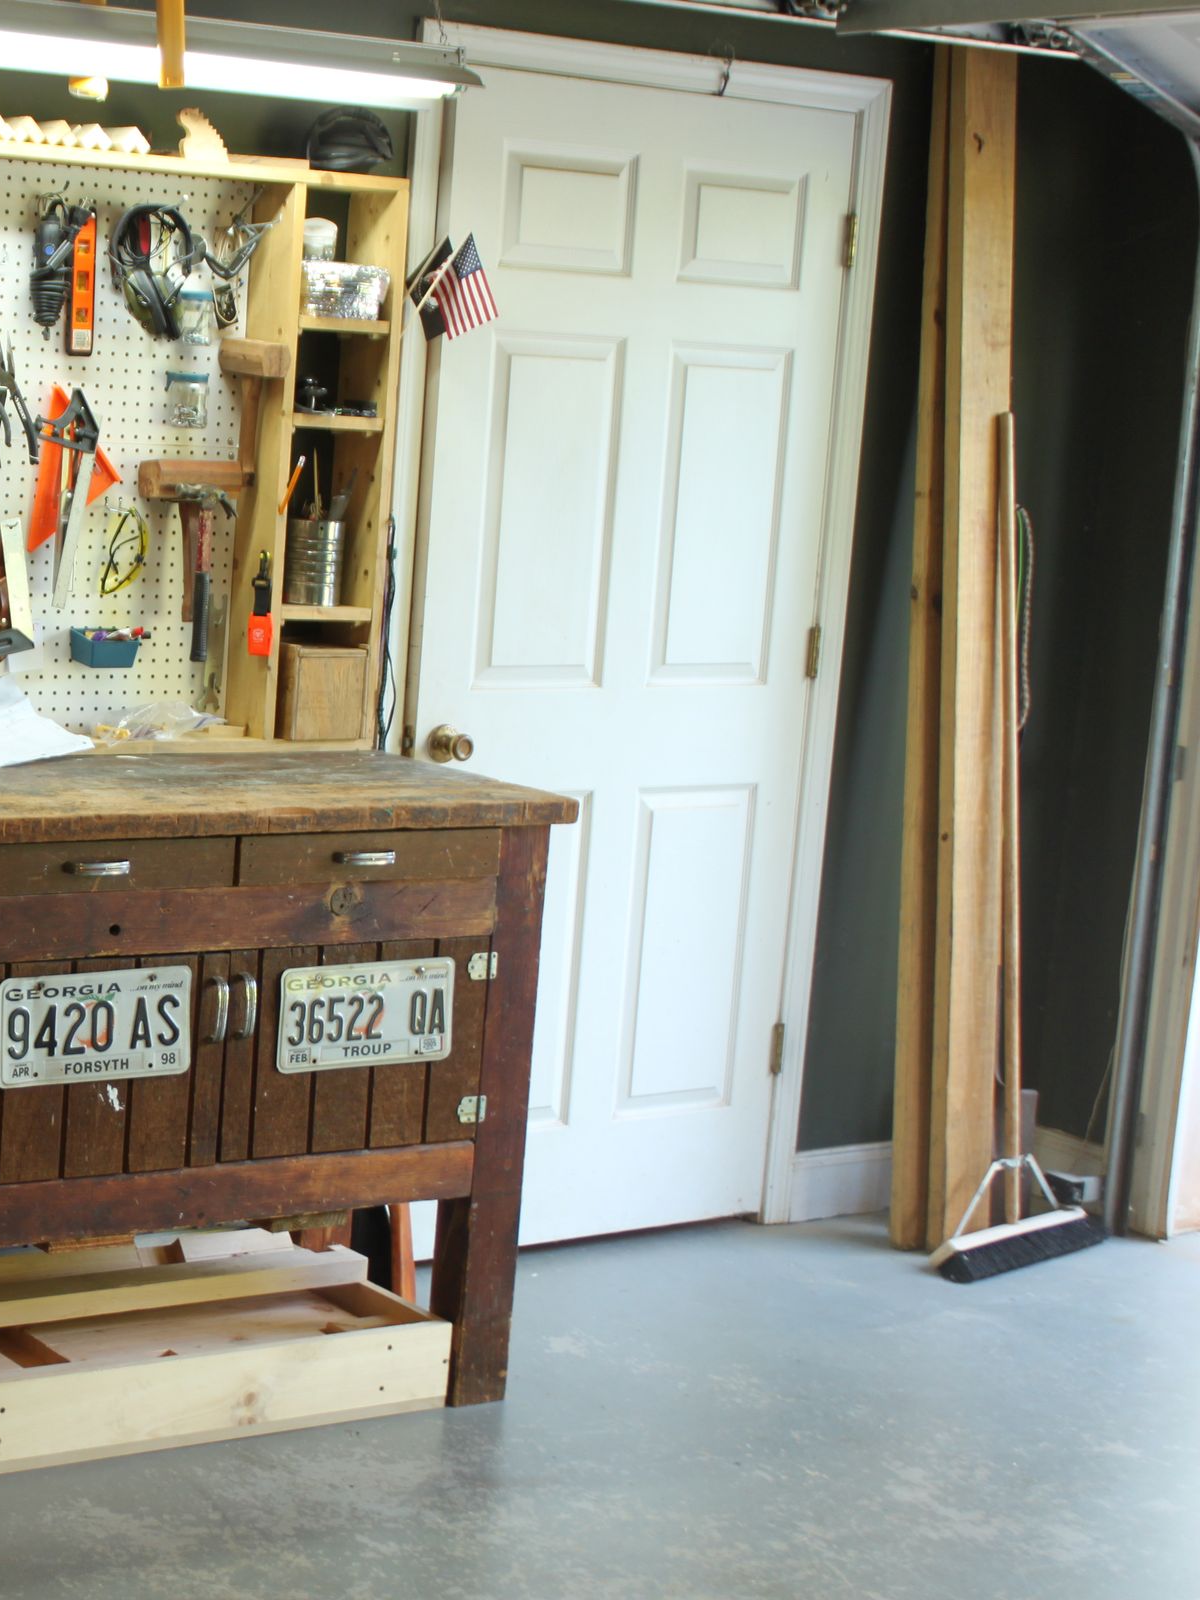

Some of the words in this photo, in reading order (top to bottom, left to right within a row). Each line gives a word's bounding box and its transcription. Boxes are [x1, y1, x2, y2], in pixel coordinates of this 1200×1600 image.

[5, 982, 122, 1001] GEORGIA
[162, 980, 183, 989] mind
[287, 973, 392, 991] GEORGIA
[289, 992, 385, 1046] 36522
[409, 988, 445, 1035] QA
[8, 1000, 115, 1060] 9420
[130, 994, 180, 1050] AS
[161, 1053, 176, 1065] 98
[289, 1052, 308, 1064] FEB
[342, 1043, 392, 1058] TROUP
[12, 1066, 30, 1079] APR
[64, 1058, 130, 1075] FORSYTH
